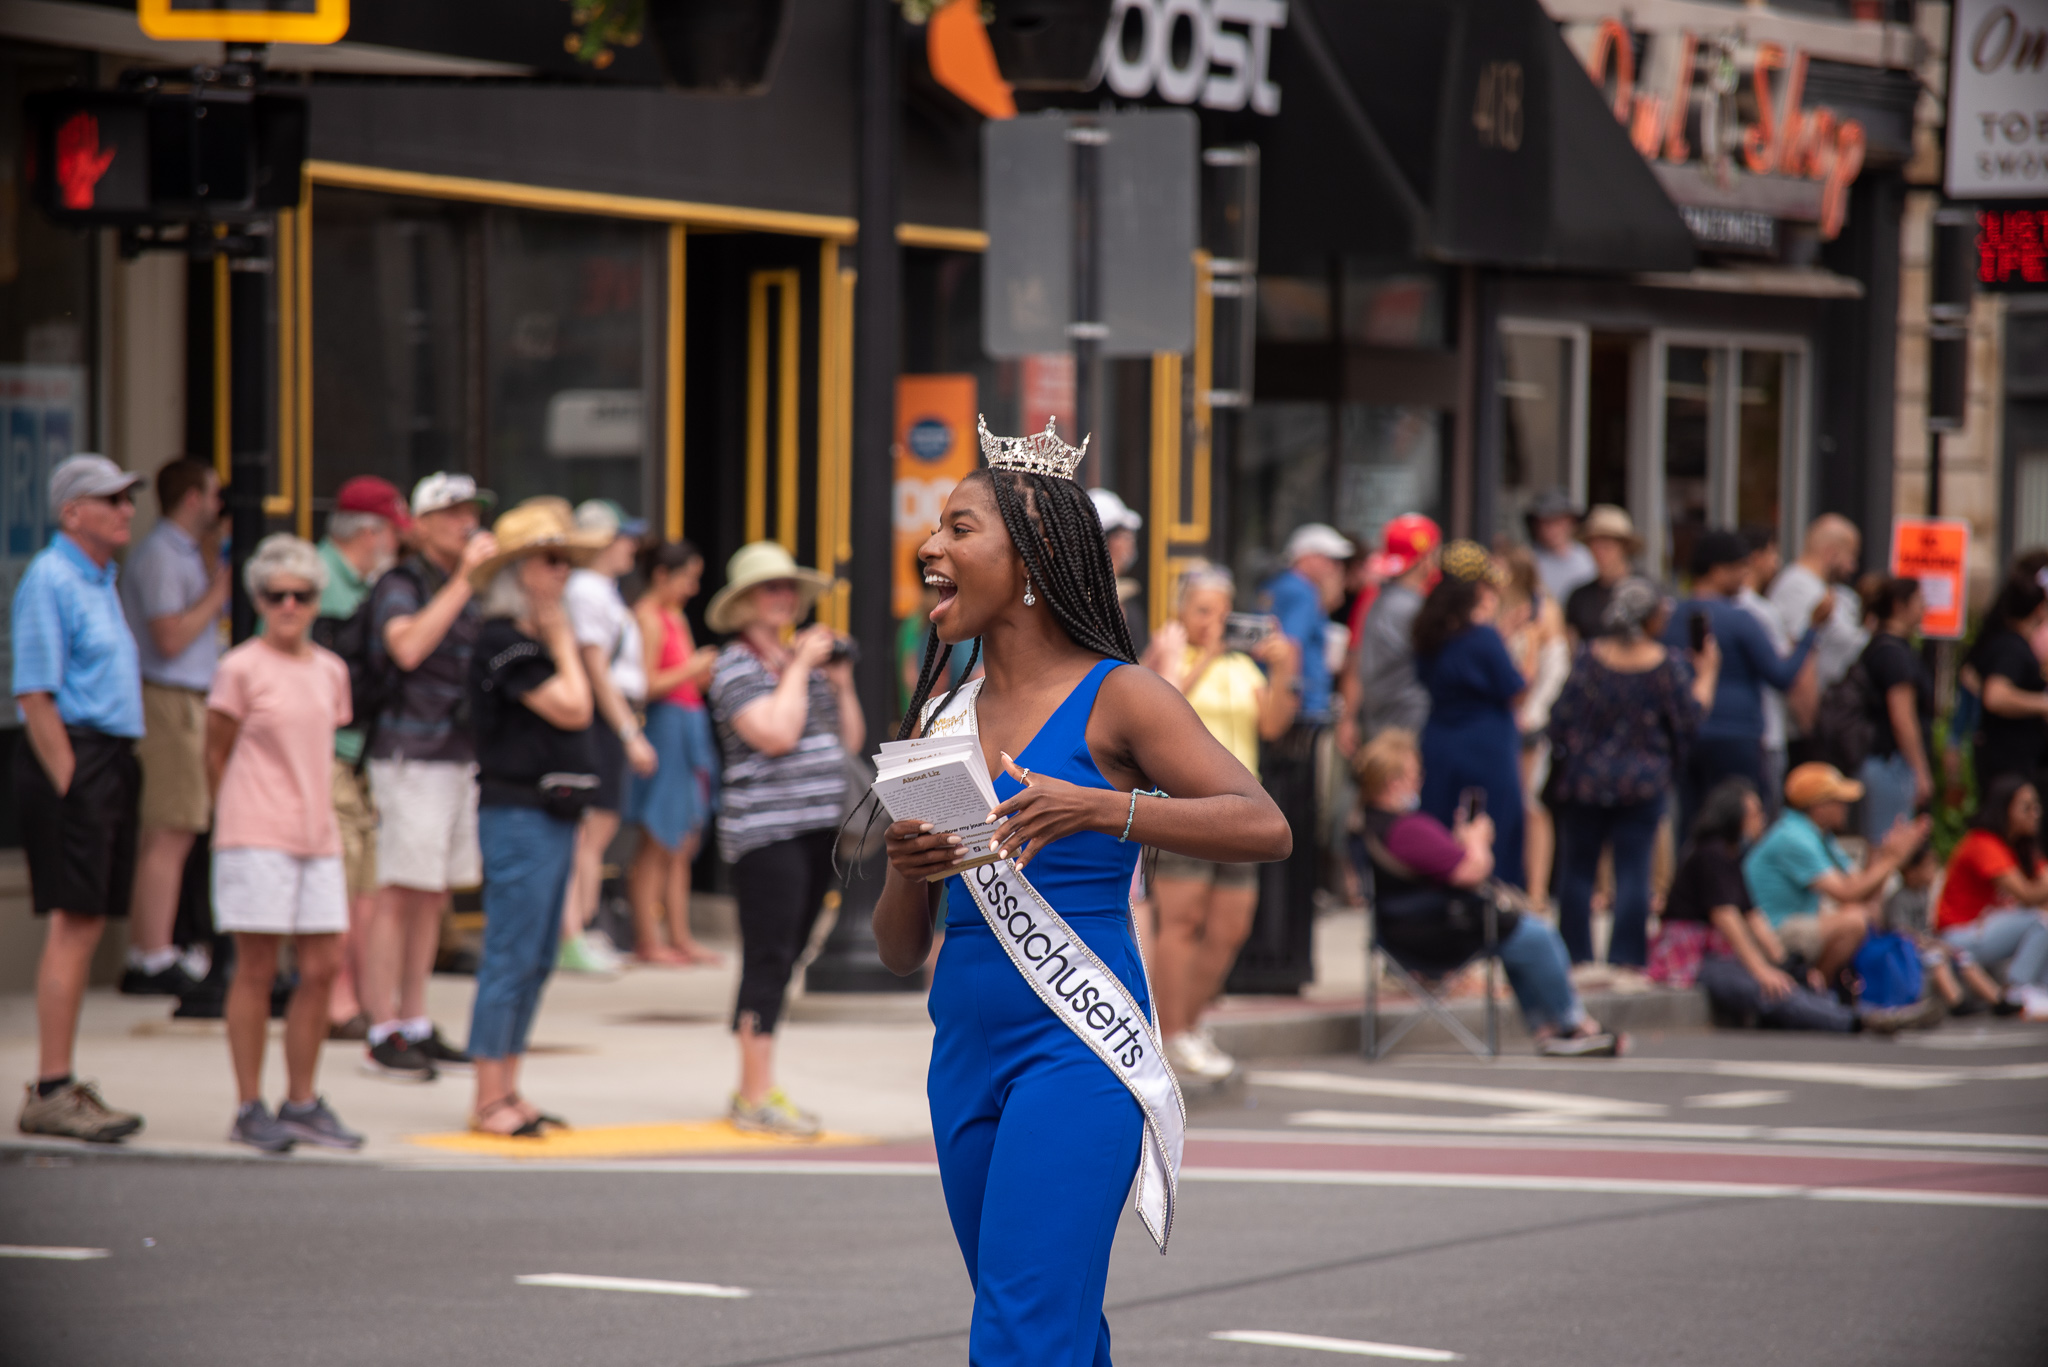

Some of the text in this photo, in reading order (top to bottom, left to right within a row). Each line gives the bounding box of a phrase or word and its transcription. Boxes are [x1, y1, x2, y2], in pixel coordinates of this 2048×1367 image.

[902, 770, 940, 785] About Liz
[969, 820, 994, 829] journy
[976, 863, 1143, 1068] assachusetts
